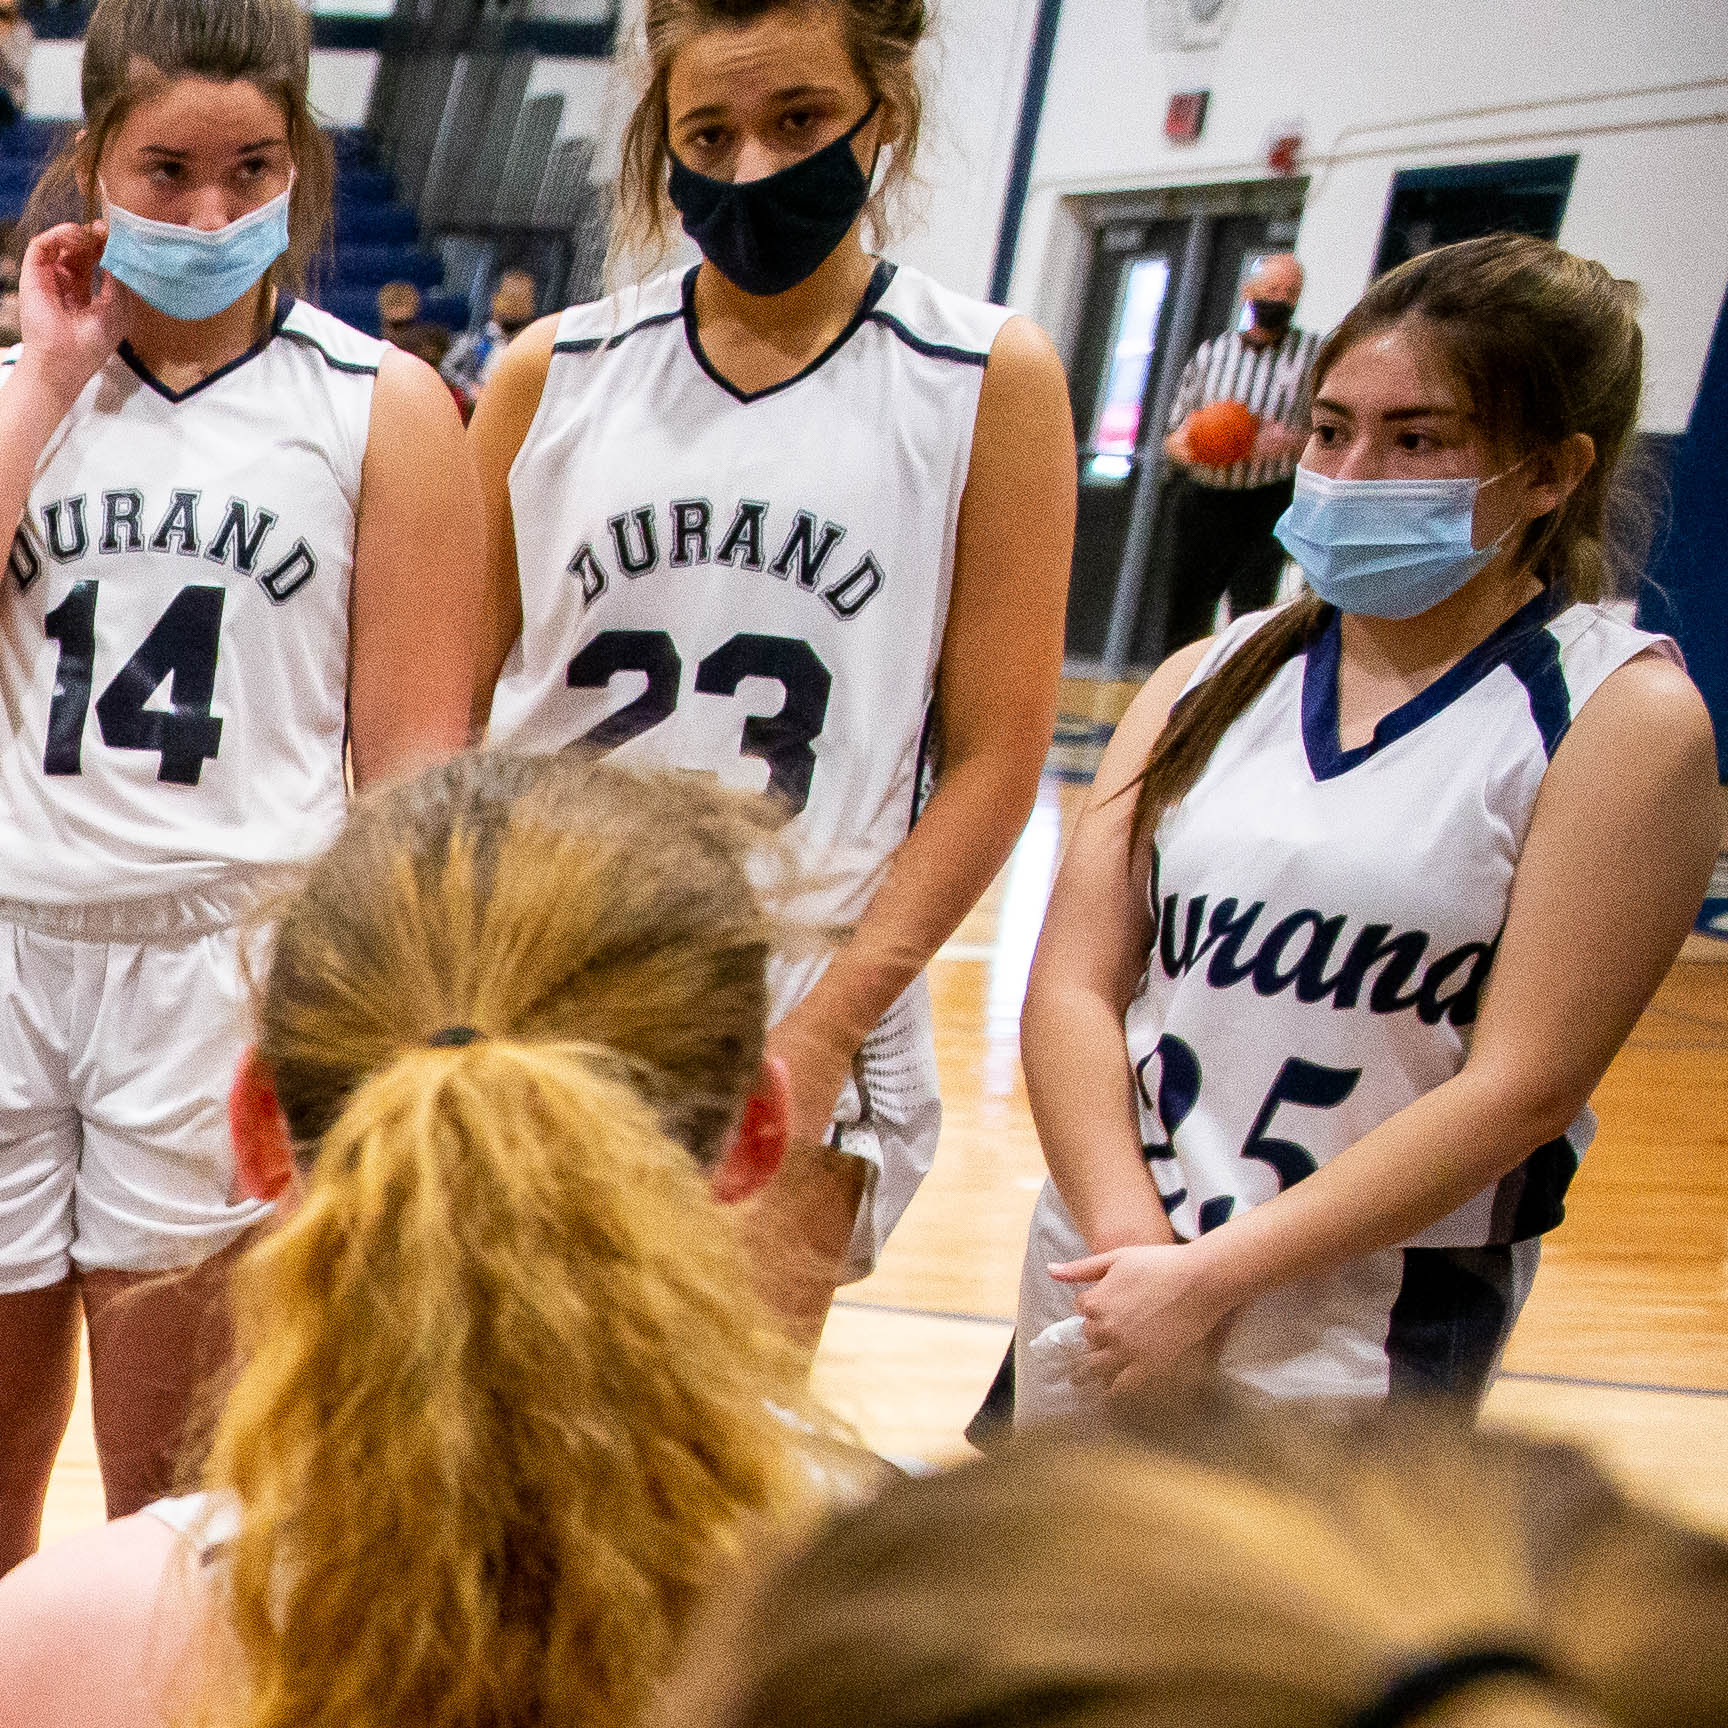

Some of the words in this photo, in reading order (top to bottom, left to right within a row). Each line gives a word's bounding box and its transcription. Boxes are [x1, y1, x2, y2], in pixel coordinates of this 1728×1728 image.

[10, 488, 319, 607] DURAND
[566, 496, 887, 623] DURAND
[43, 578, 227, 787] 14
[558, 629, 834, 820] 23
[1154, 892, 1501, 1027] urand
